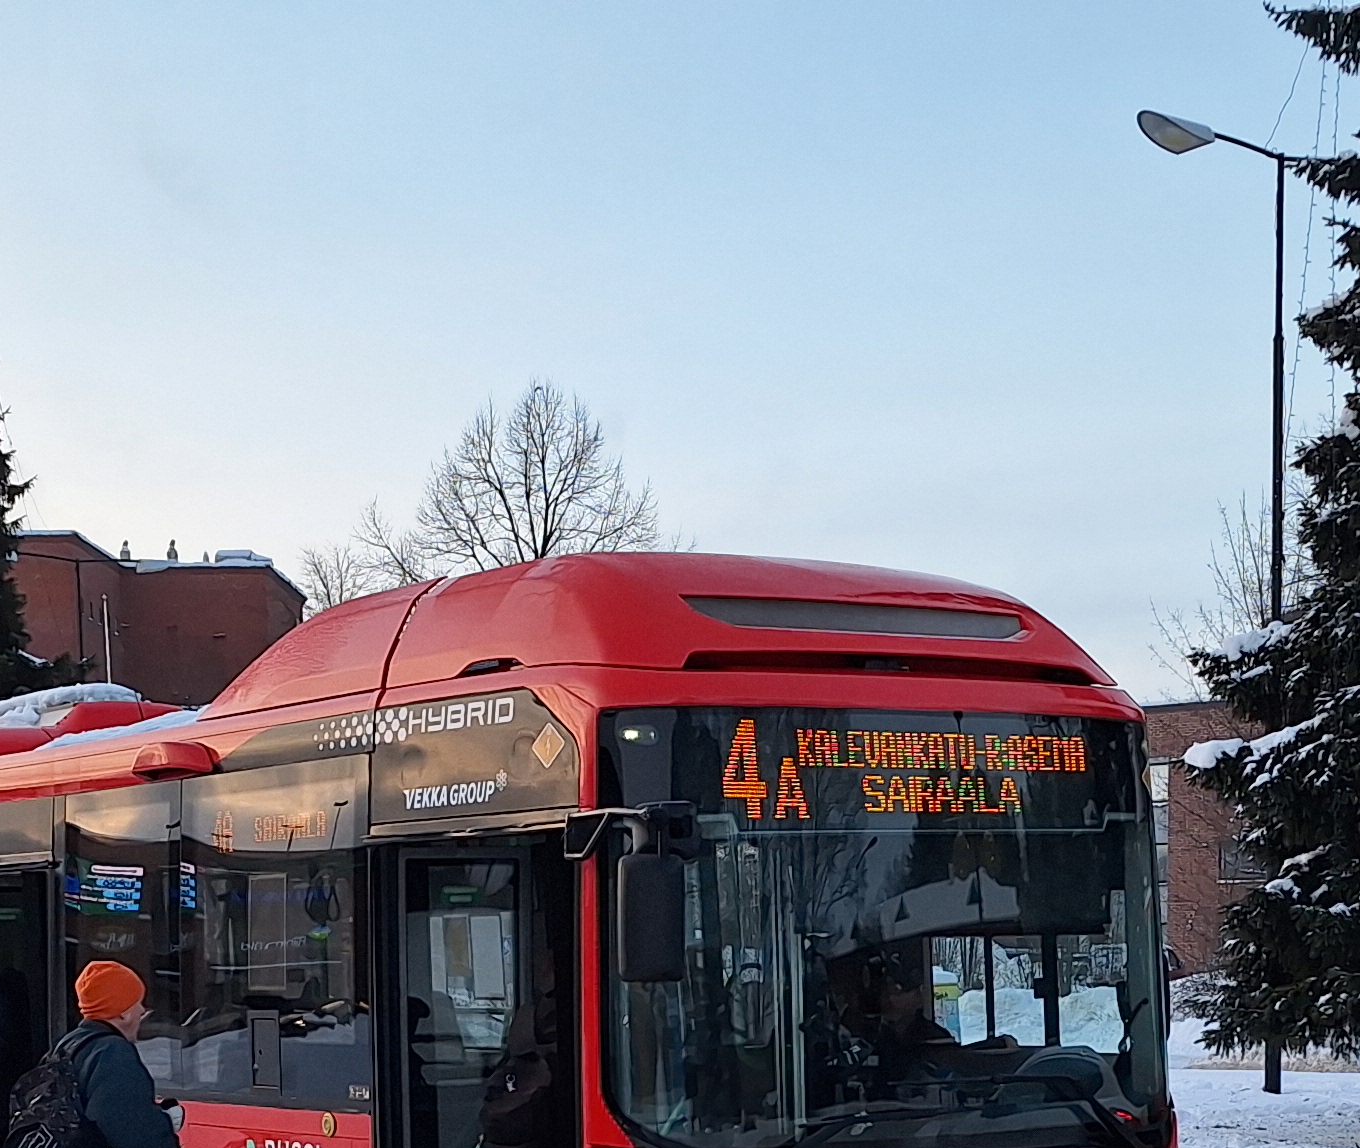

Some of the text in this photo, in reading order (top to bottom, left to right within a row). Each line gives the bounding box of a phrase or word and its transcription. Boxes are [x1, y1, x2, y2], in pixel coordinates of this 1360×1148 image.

[408, 697, 514, 735] HYBRID
[403, 780, 495, 810] VEKKA GROUP
[862, 774, 1022, 813] SAIRAALA
